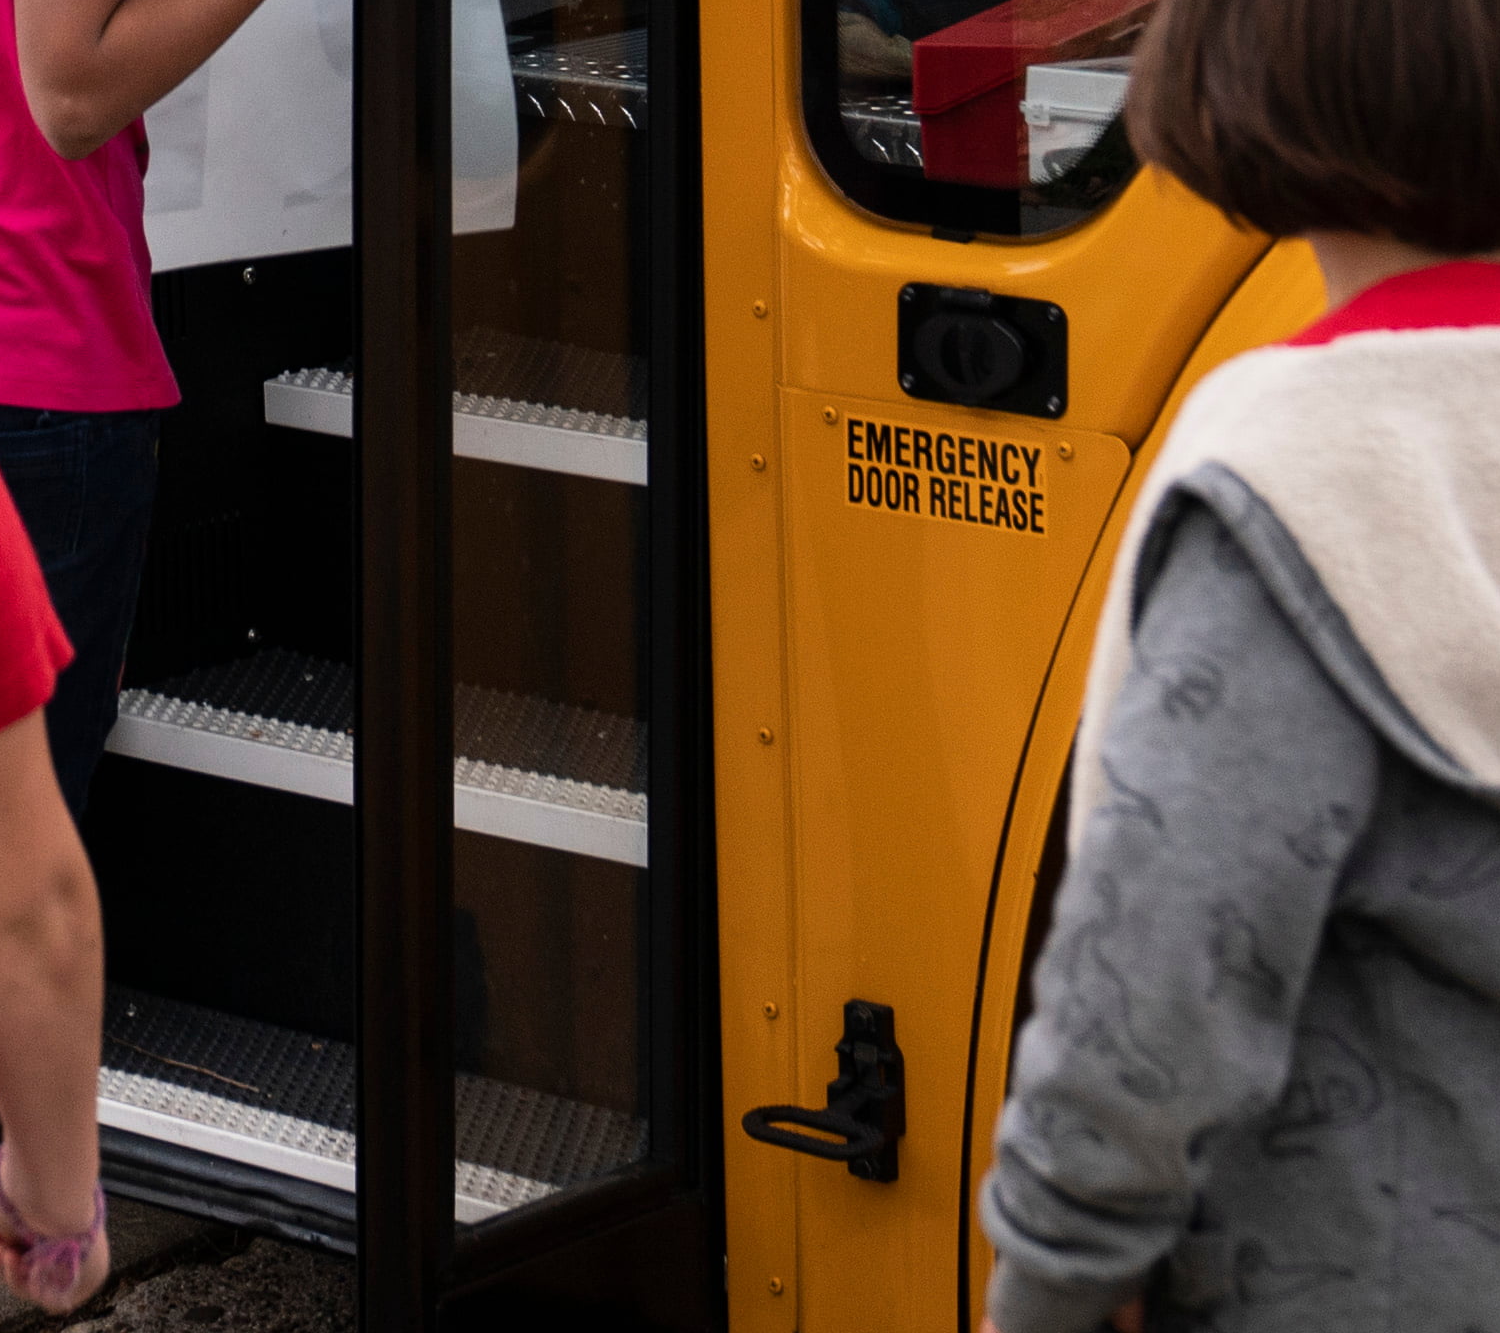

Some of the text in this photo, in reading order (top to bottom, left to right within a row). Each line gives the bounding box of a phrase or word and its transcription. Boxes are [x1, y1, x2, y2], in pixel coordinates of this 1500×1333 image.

[847, 418, 1042, 489] EMERGENCY
[848, 463, 1045, 534] DOOR RELEASE
